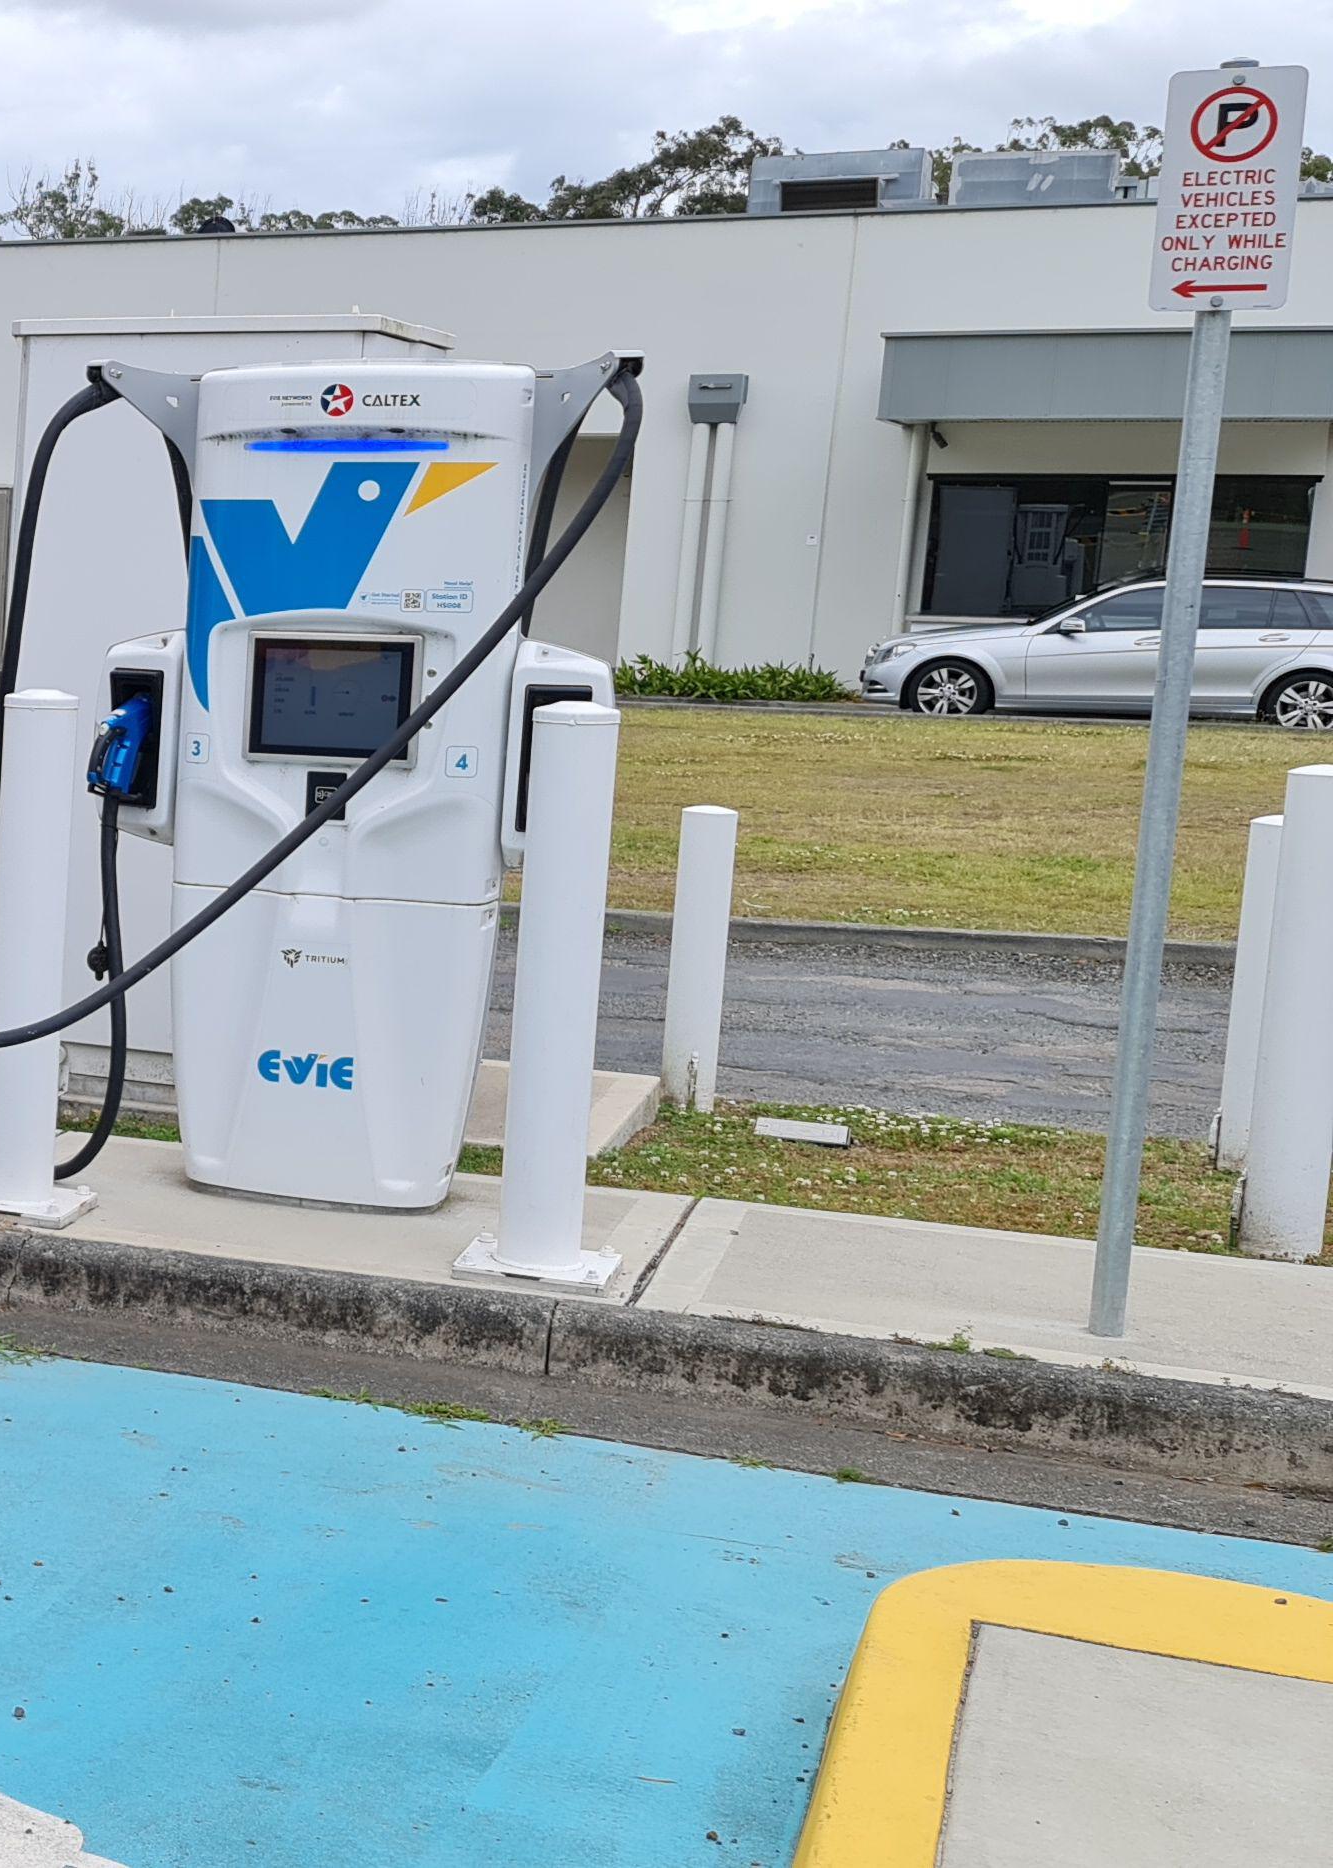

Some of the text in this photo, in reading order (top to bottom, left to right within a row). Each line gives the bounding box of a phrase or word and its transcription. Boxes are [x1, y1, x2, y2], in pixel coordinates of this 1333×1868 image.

[1182, 168, 1277, 187] ELECTRIC
[1180, 190, 1276, 208] VEHICLES
[1175, 211, 1277, 229] EXCEPTED
[1161, 232, 1287, 251] ONLY WHILE
[1171, 254, 1273, 272] CHARGING
[362, 394, 421, 407] CALTEX
[431, 592, 468, 600] Station ID
[191, 739, 201, 757] 3
[455, 753, 469, 770] 4
[305, 954, 345, 965] TRITIUM
